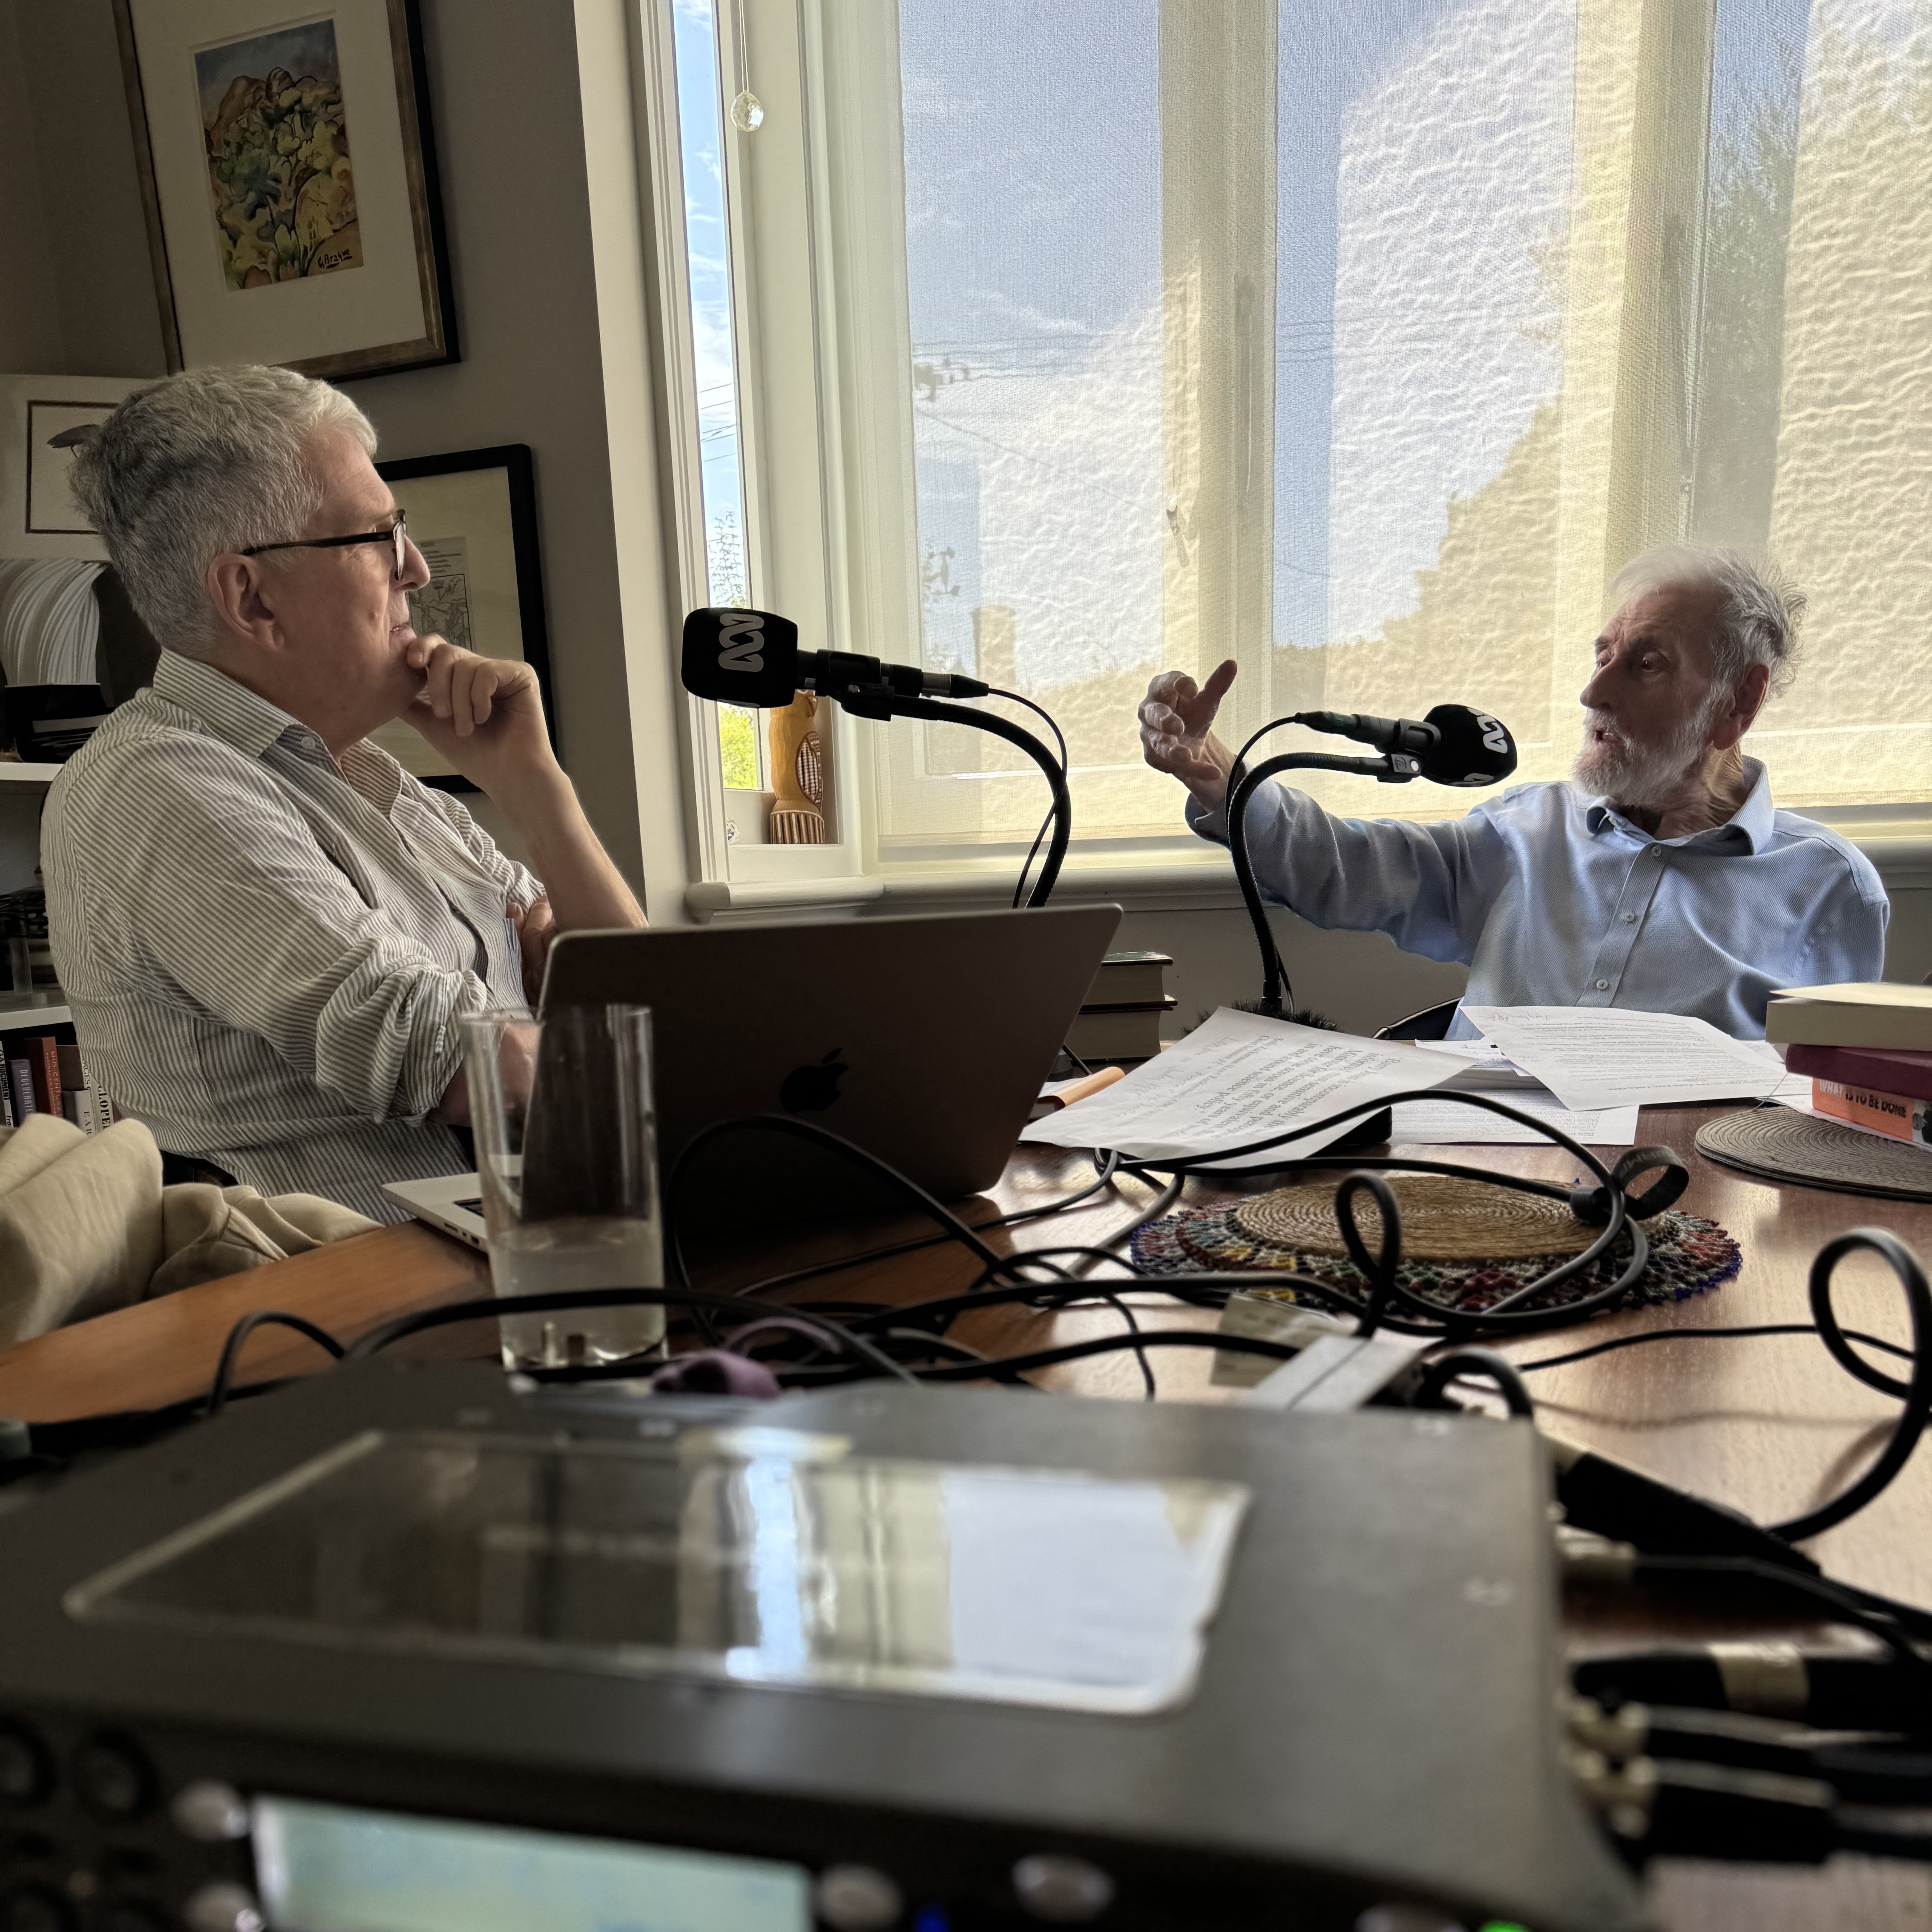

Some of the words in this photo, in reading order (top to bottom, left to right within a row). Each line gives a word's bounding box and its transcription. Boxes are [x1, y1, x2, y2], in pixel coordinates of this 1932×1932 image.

[1314, 1045, 1342, 1057] have
[0, 1064, 10, 1100] DOCUMENT
[51, 1051, 62, 1110] MID-CENTURY
[1226, 1071, 1262, 1091] science
[19, 1069, 34, 1116] DEGENERATE
[1232, 1090, 1260, 1102] fifty
[1277, 1082, 1319, 1104] sensitive
[1278, 1084, 1346, 1120] incomparably
[1819, 1079, 1843, 1097] WHAT
[1846, 1087, 1853, 1101] IS
[1855, 1090, 1867, 1105] TO
[1869, 1094, 1879, 1109] BE
[1881, 1101, 1906, 1118] DONE
[1208, 1102, 1237, 1118] years
[1259, 1104, 1280, 1115] and
